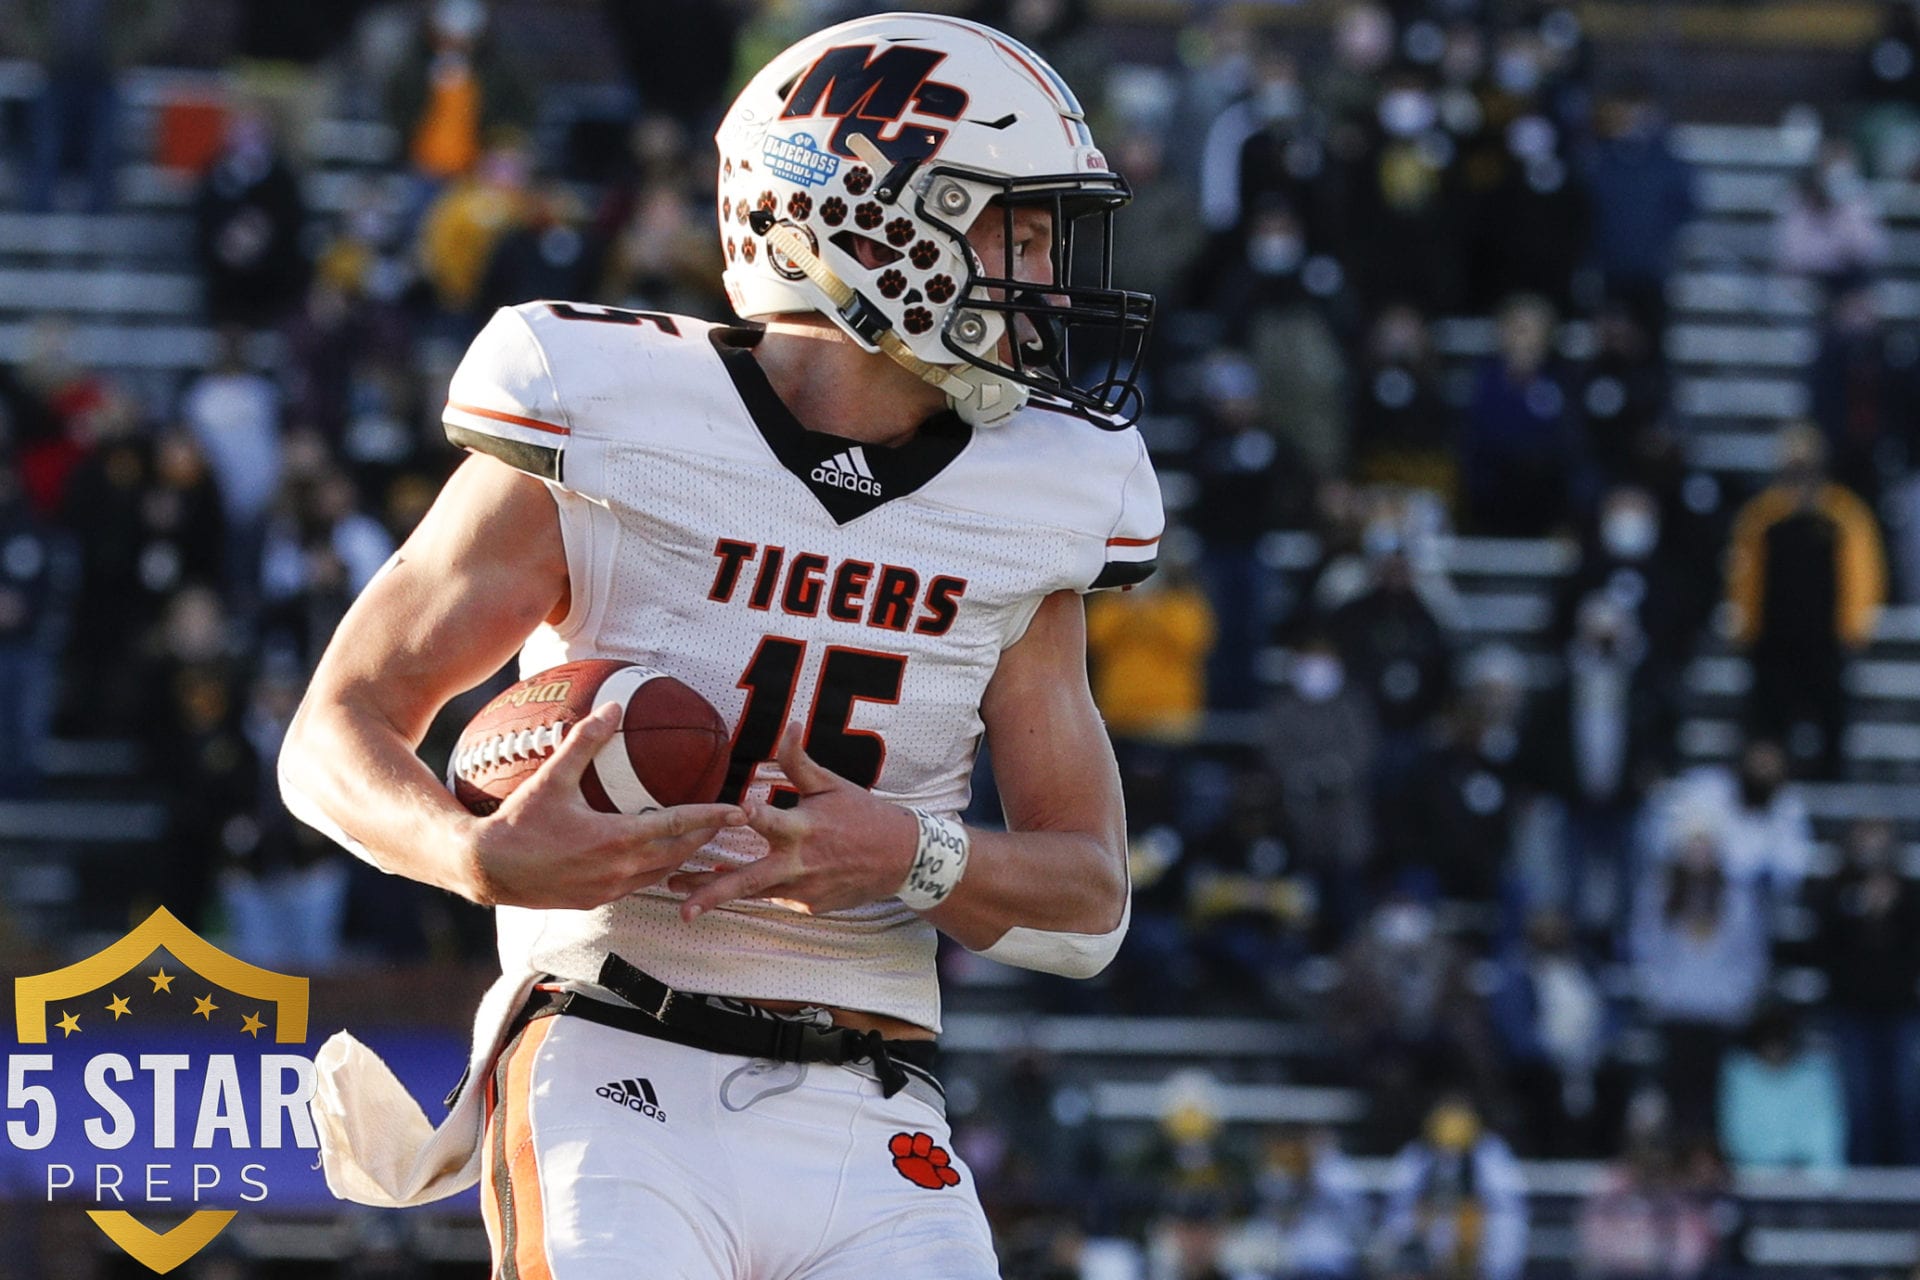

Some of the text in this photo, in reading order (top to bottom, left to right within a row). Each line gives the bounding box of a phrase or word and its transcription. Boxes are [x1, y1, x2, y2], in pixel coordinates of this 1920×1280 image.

[763, 136, 838, 174] BLUECROSS
[810, 467, 882, 497] adidas
[706, 537, 968, 637] TIGERS
[483, 680, 573, 718] Wilson
[716, 634, 909, 809] 15
[595, 1086, 667, 1123] adidas
